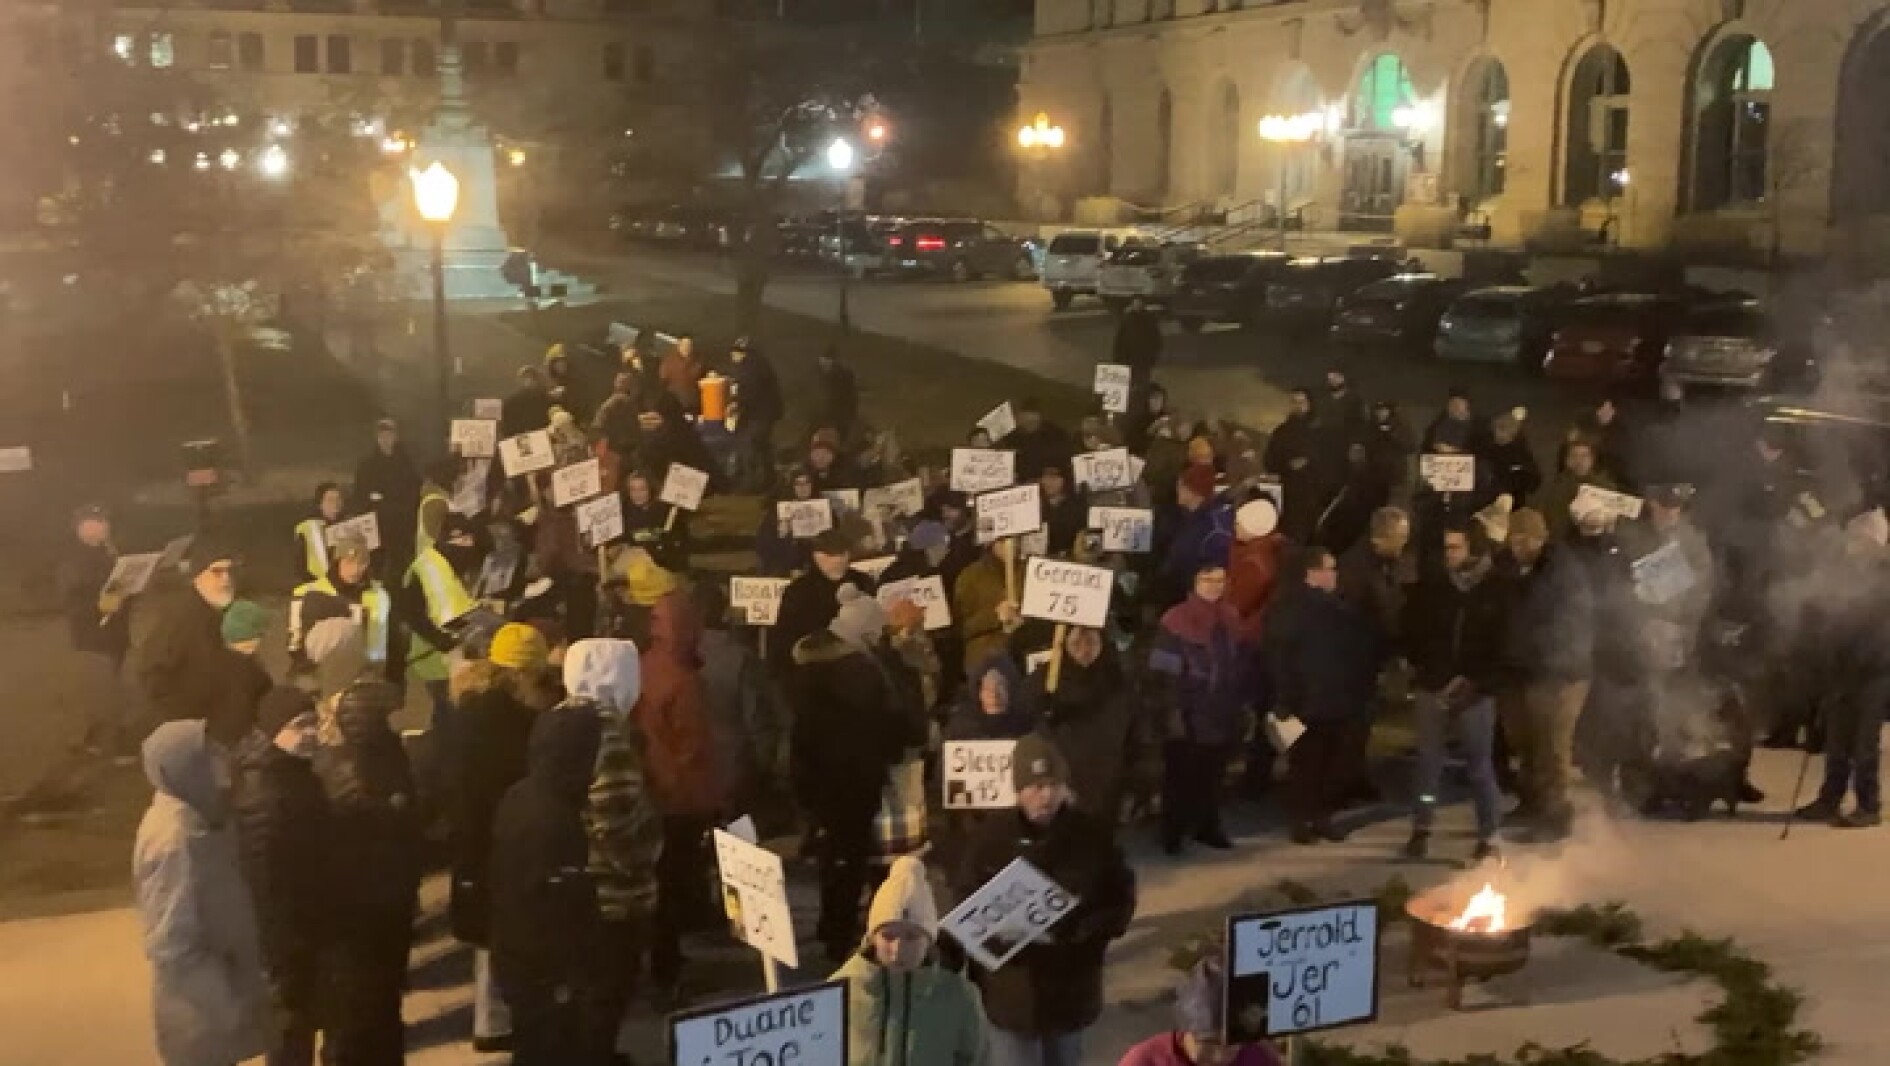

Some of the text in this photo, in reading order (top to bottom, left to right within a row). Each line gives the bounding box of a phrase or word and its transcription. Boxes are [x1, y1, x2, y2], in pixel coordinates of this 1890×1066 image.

[1034, 561, 1102, 590] Gerald
[1047, 591, 1079, 618] 75
[1027, 888, 1069, 925] 66
[1257, 911, 1362, 959] Jerrold
[713, 998, 814, 1047] Duane
[1291, 995, 1321, 1027] 61
